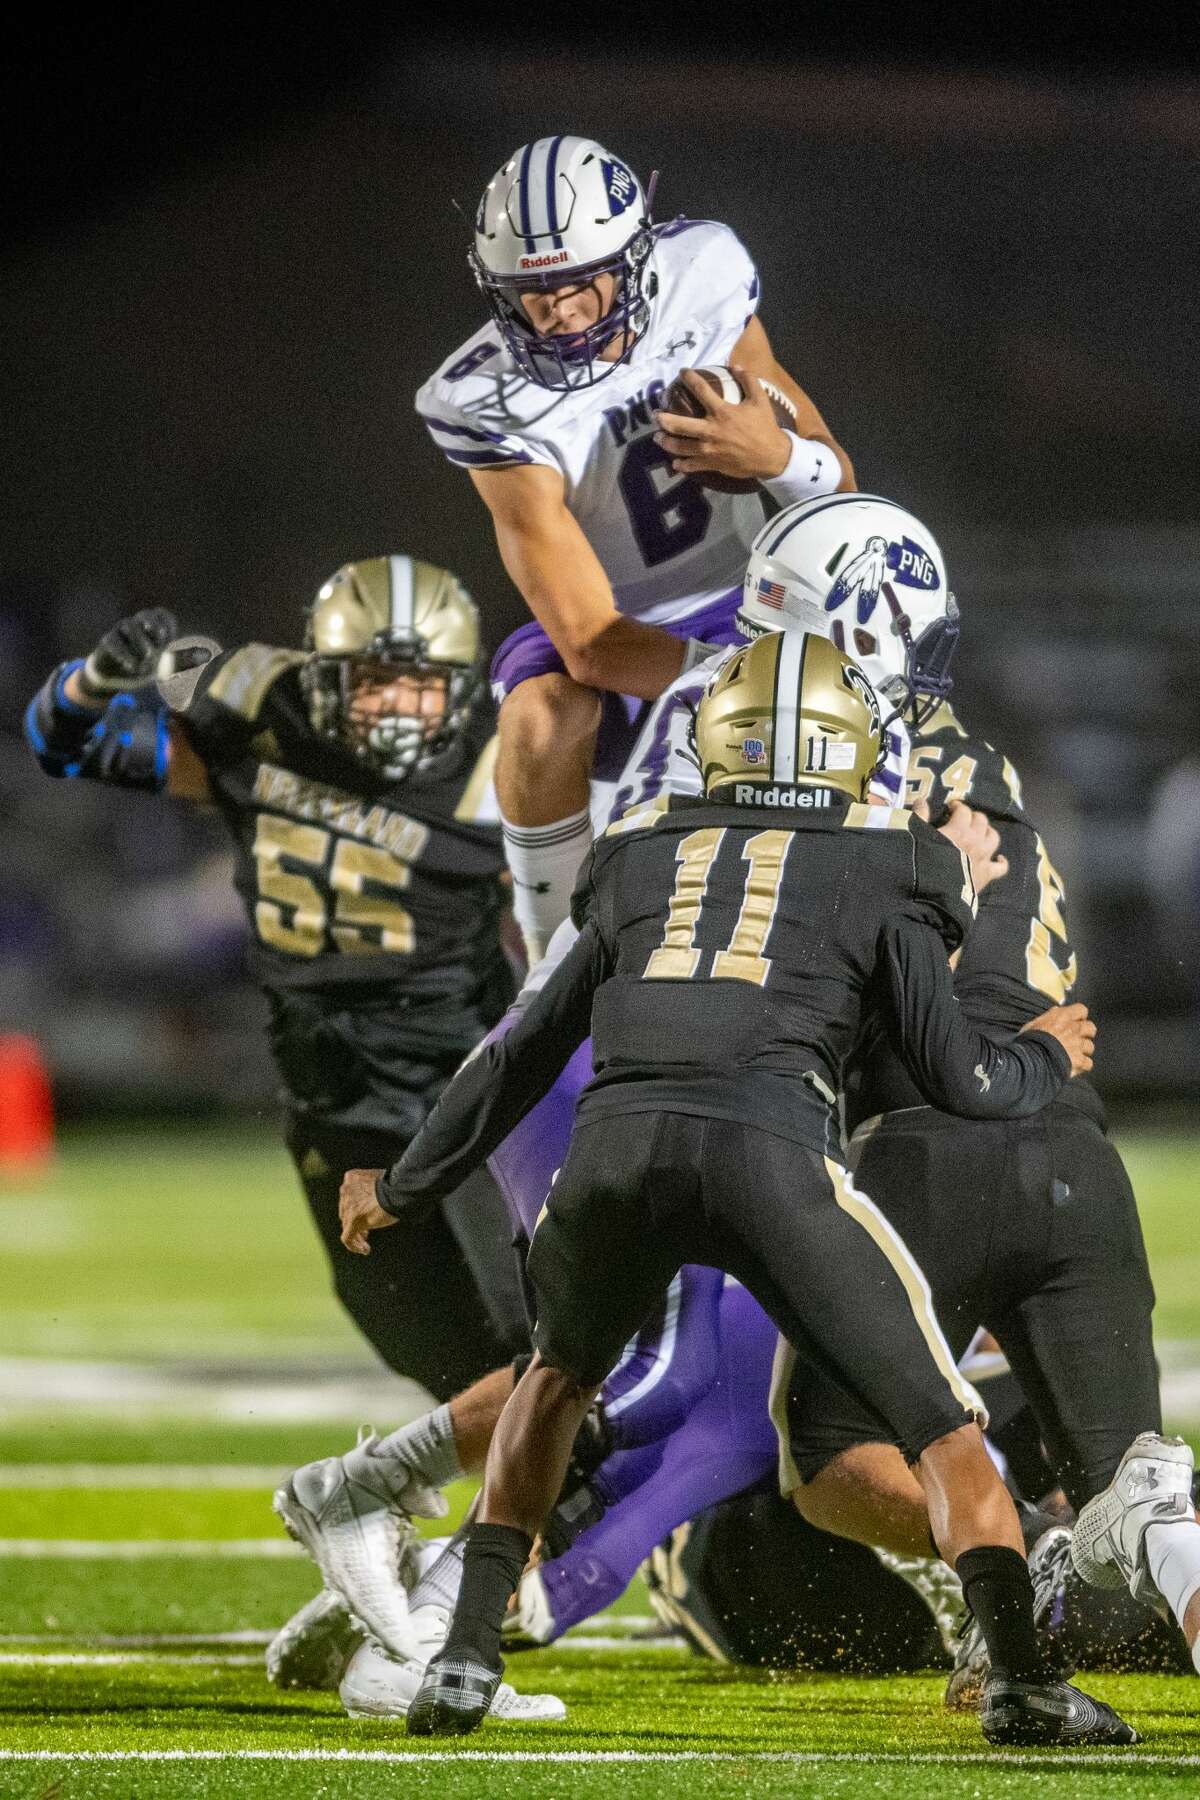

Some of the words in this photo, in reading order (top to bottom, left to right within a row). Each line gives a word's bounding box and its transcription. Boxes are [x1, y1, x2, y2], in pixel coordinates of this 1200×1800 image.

[610, 166, 633, 204] PNG
[520, 252, 569, 269] Riddell
[617, 430, 713, 569] 6
[898, 549, 934, 585] PNG
[804, 735, 838, 772] 11
[905, 746, 978, 806] 54
[735, 784, 832, 809] Riddell
[252, 813, 416, 960] 55
[641, 827, 797, 988] 11
